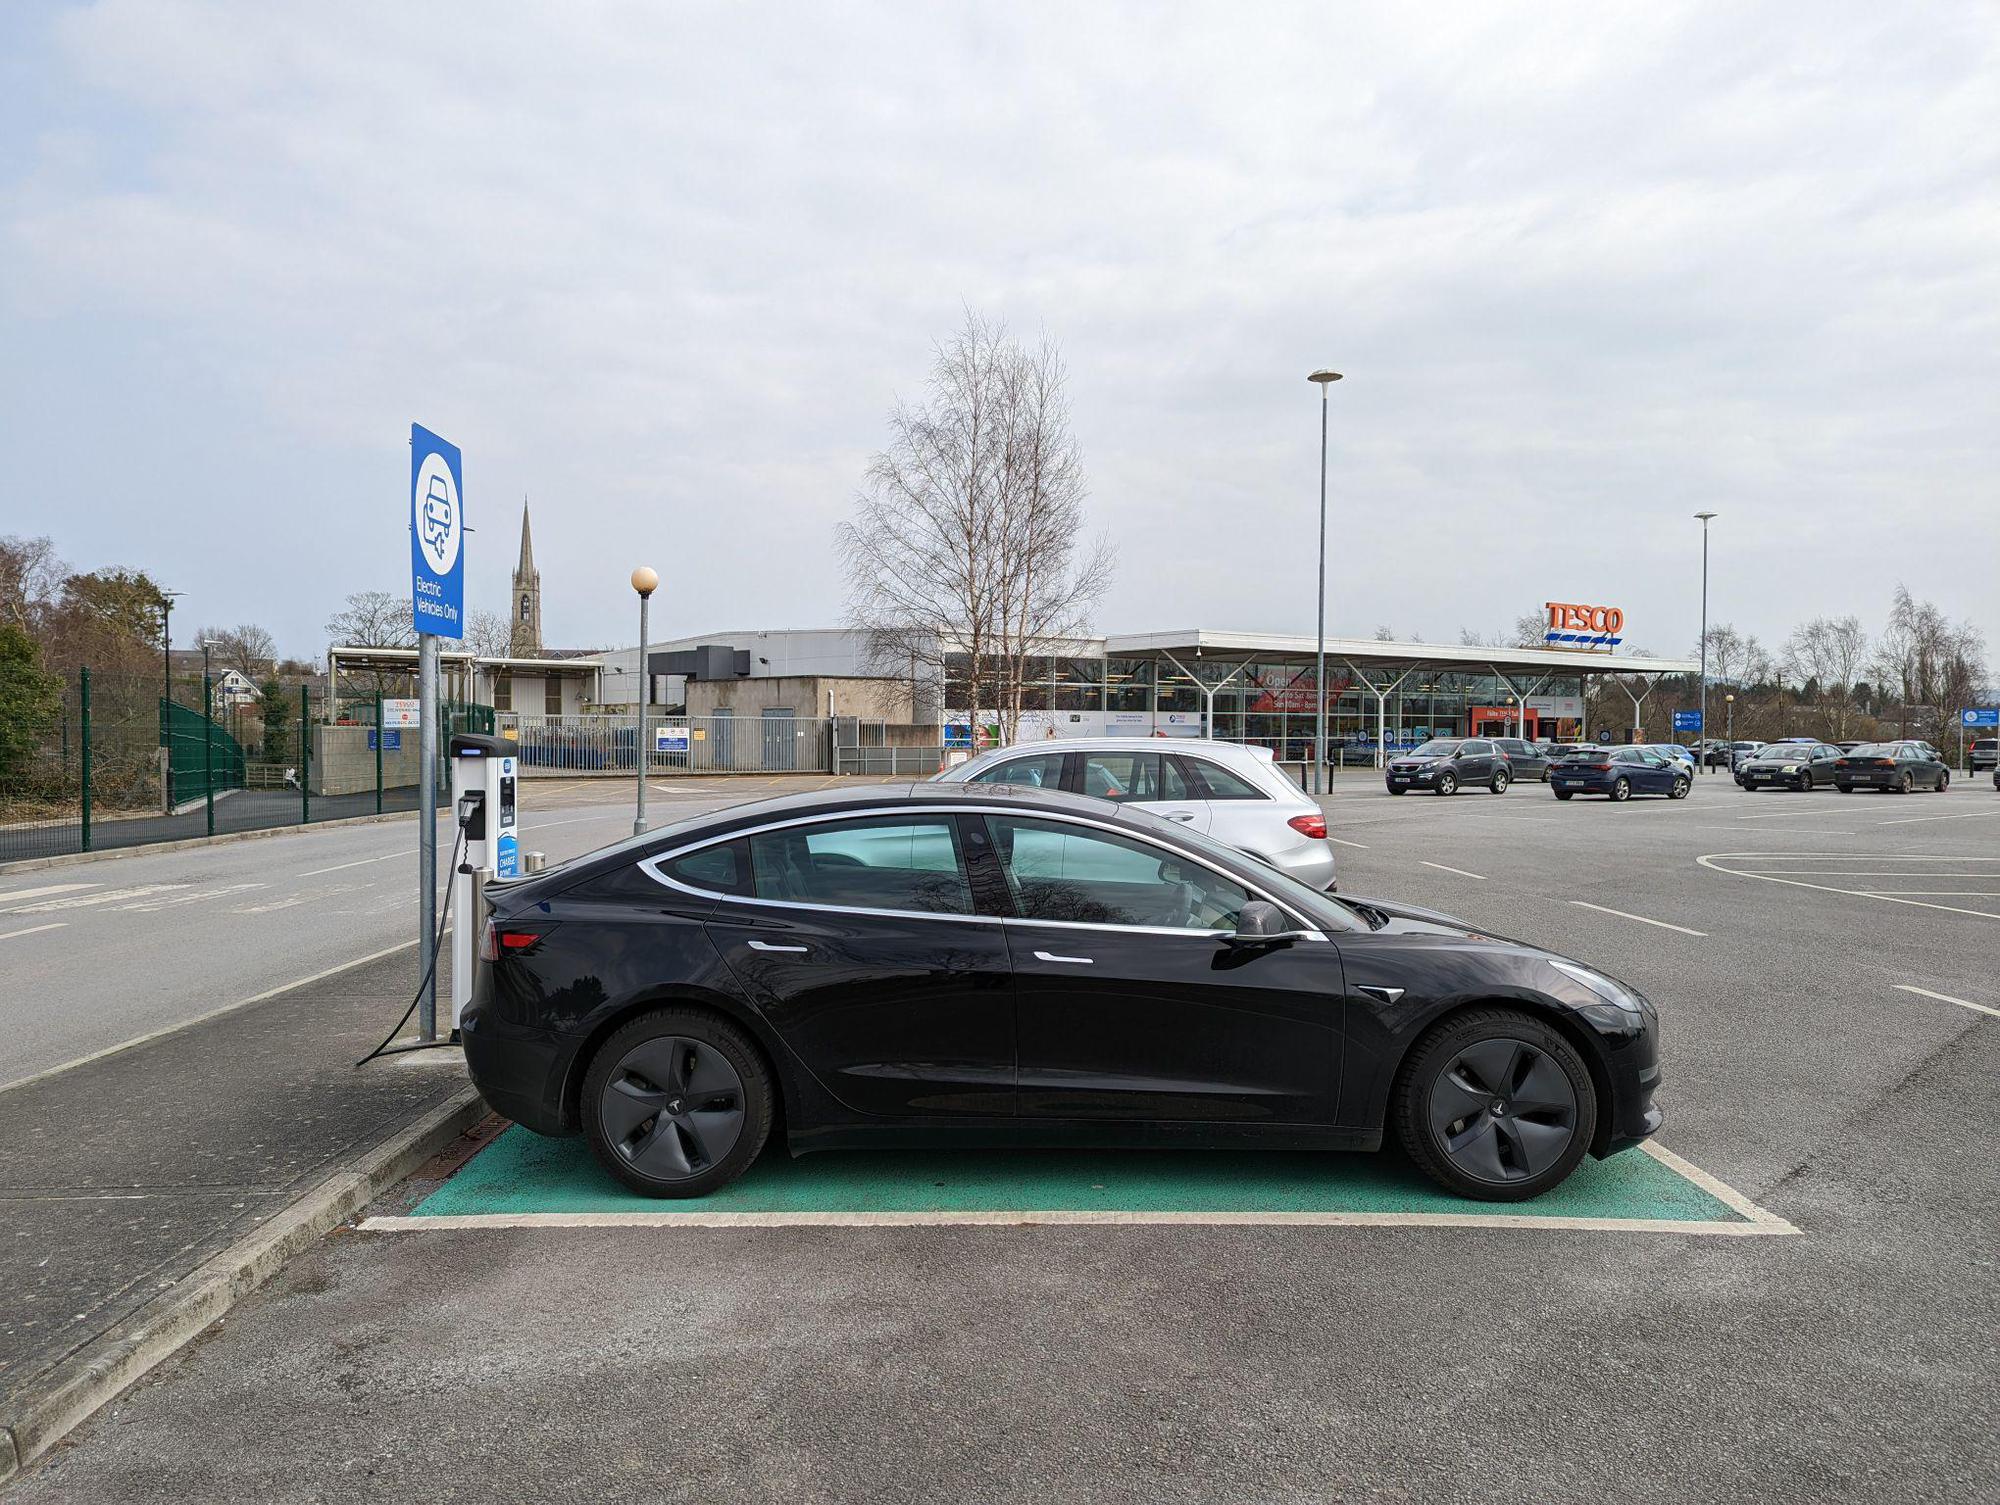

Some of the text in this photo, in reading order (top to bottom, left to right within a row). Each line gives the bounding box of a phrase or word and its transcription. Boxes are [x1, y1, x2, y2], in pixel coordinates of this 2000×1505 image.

[416, 575, 442, 597] Electric
[416, 595, 458, 624] Vehicles Only
[1545, 602, 1624, 634] TESCO
[1266, 674, 1291, 689] Open
[499, 855, 516, 868] CHARGE
